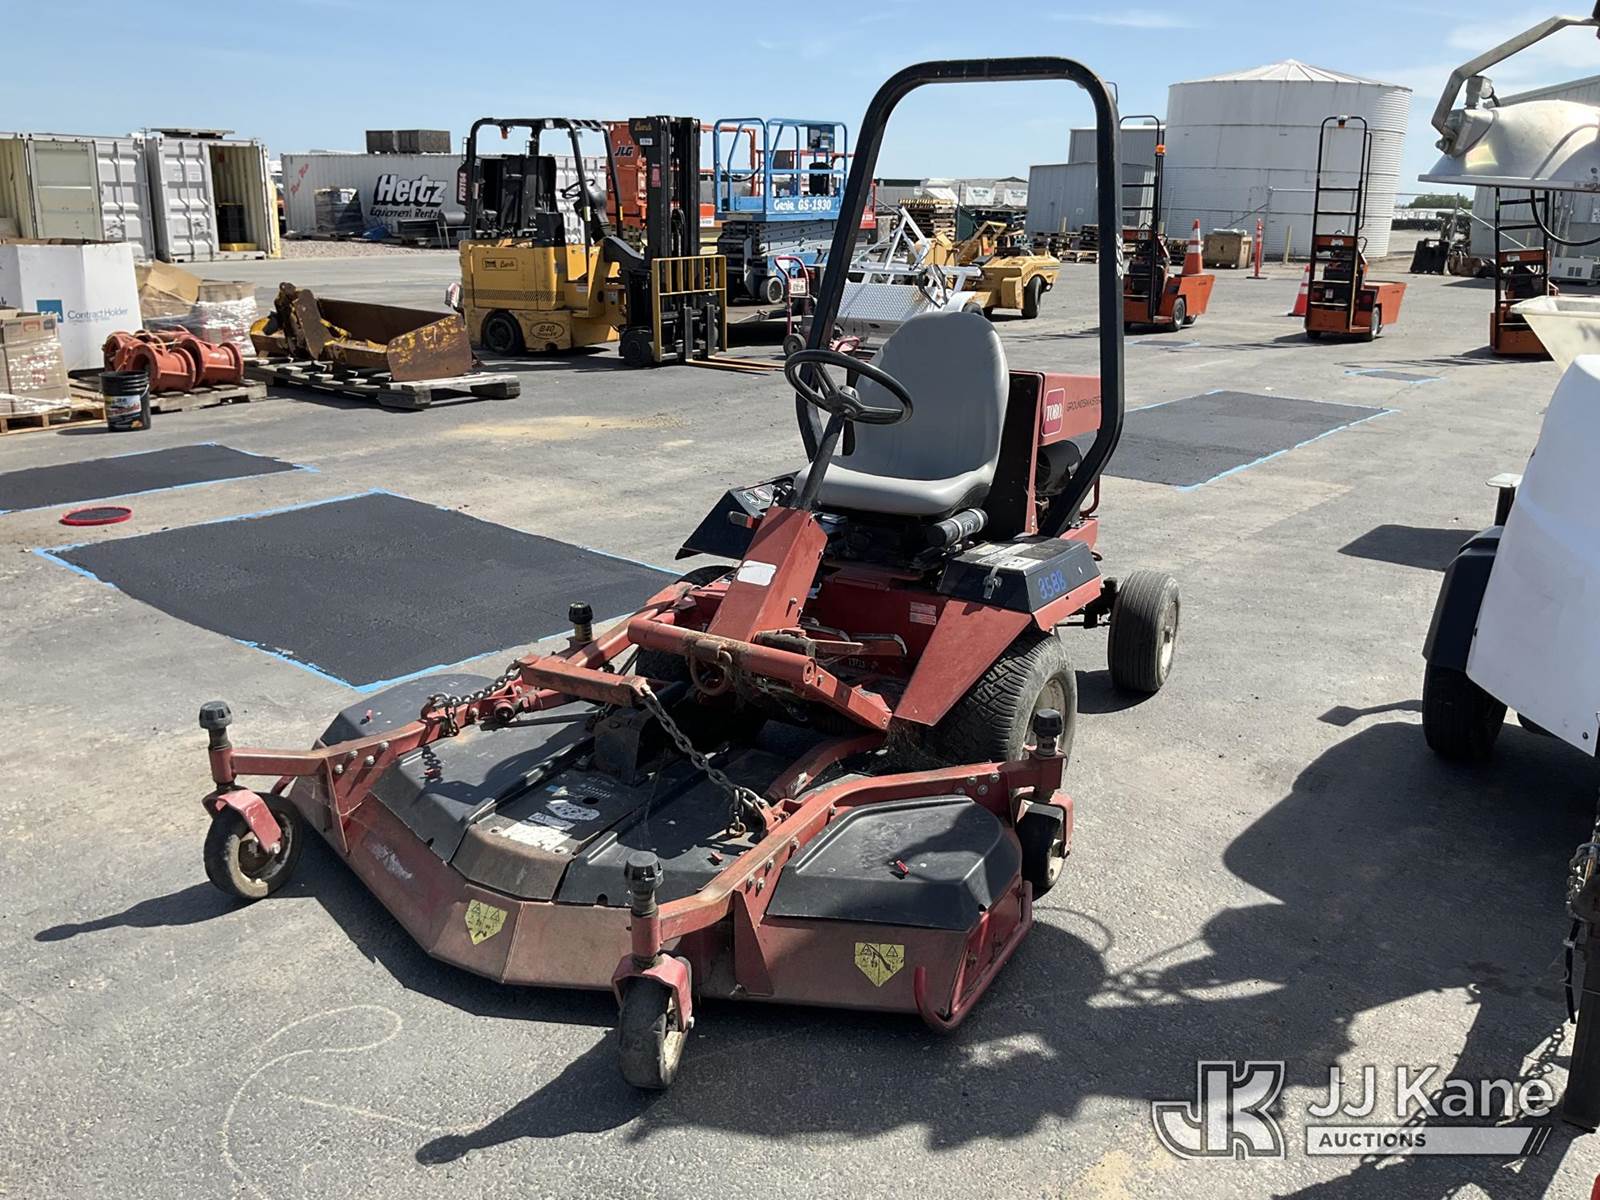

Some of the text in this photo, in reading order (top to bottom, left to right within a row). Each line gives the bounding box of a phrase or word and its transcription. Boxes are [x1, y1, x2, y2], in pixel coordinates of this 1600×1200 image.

[615, 146, 633, 156] JLG
[373, 174, 448, 207] Hertz
[773, 199, 795, 211] Genie
[67, 310, 103, 320] Contract
[104, 307, 128, 318] Holder
[1045, 402, 1063, 422] TORO
